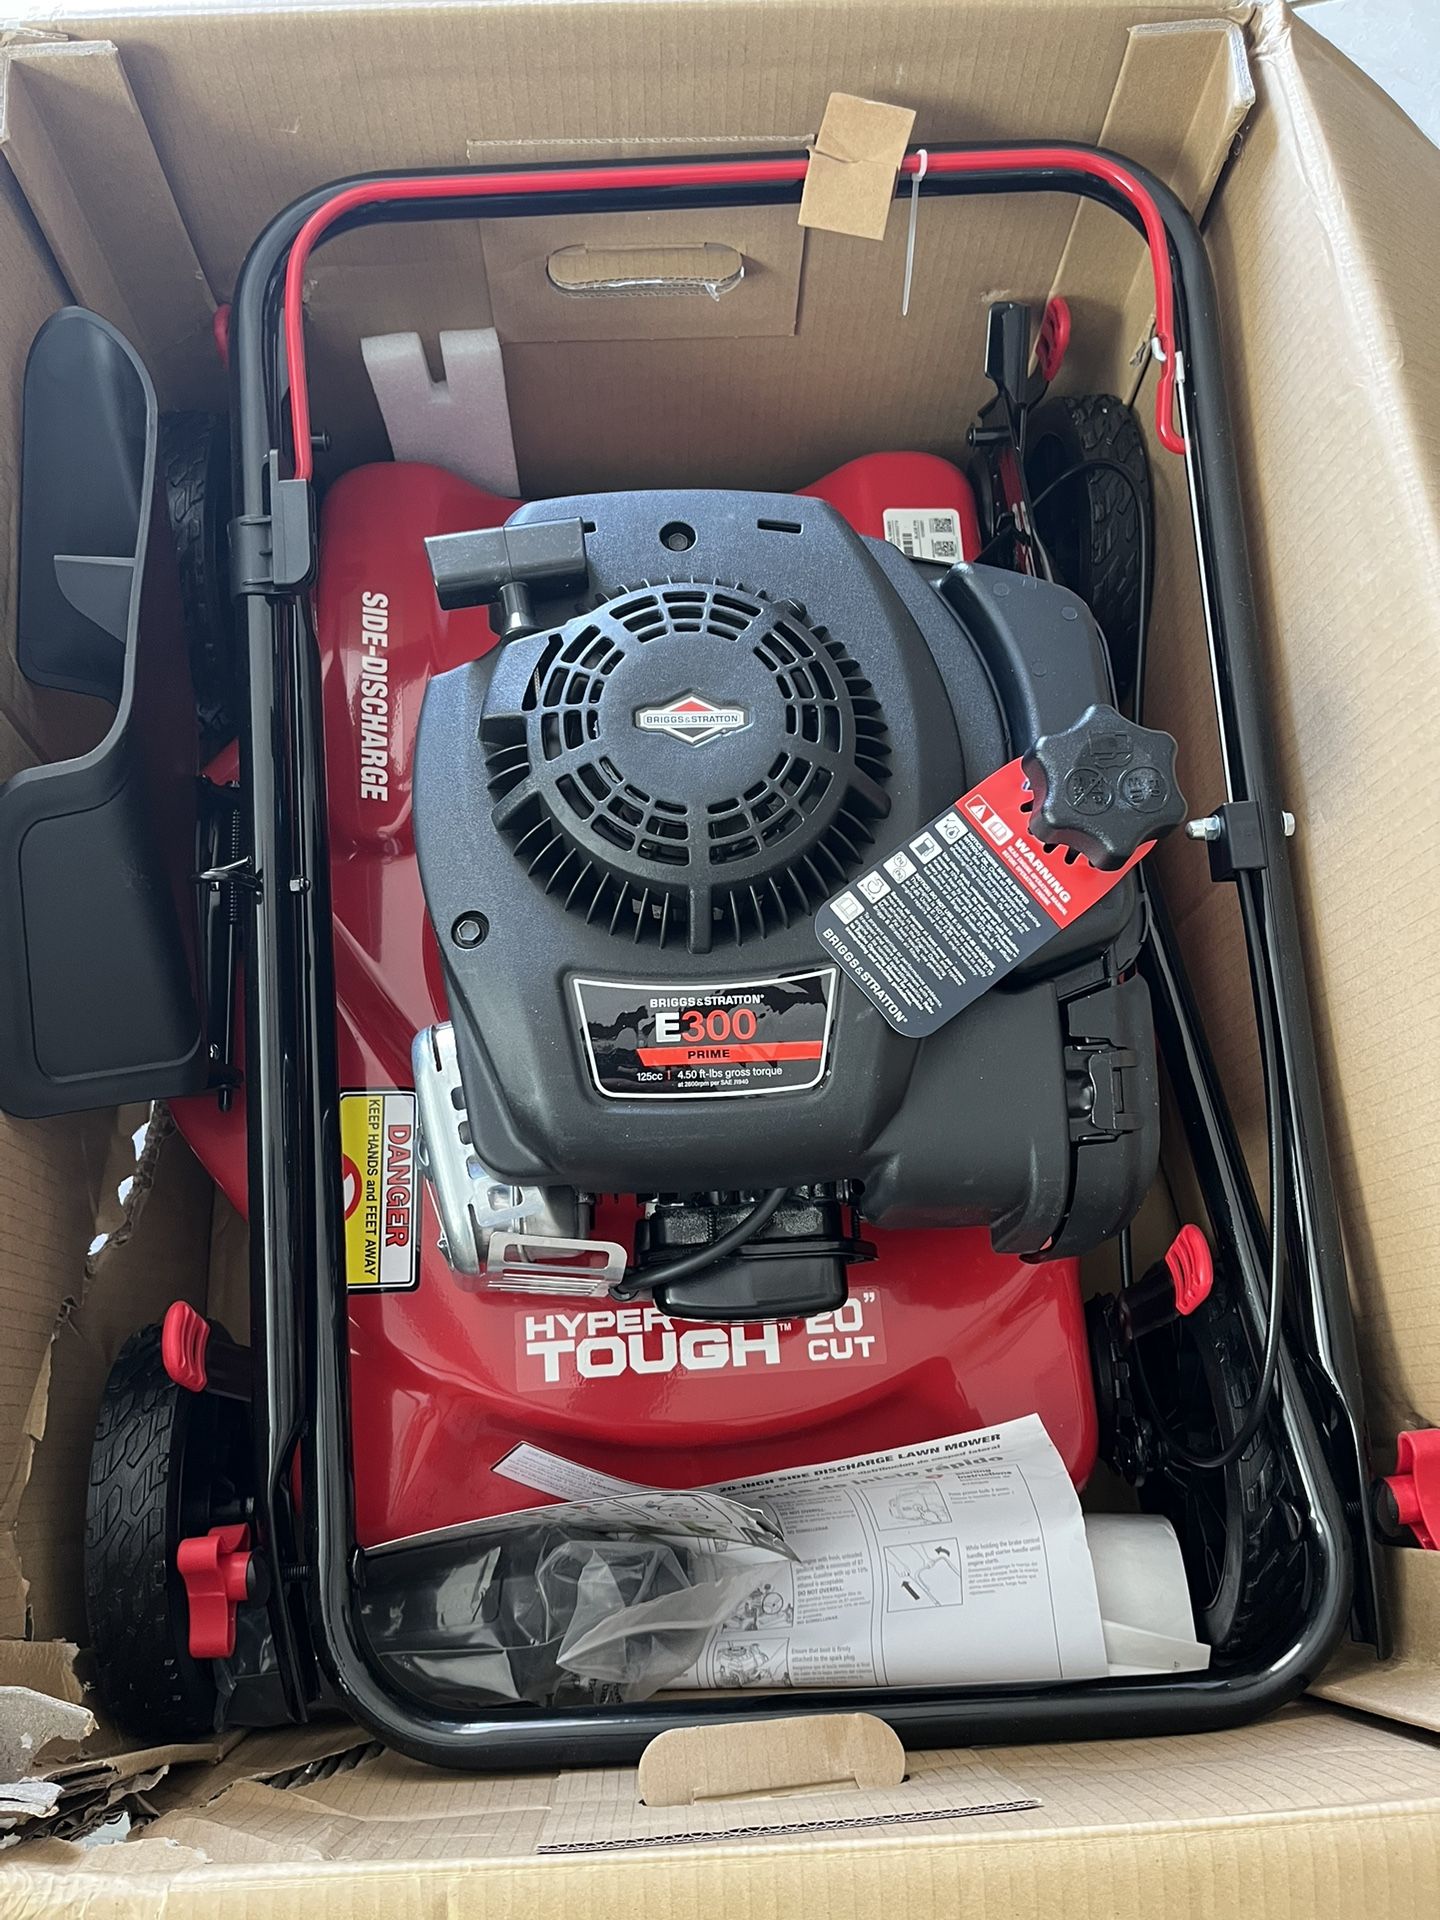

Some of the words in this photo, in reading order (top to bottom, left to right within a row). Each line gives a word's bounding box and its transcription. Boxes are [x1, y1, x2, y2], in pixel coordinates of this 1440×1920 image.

[361, 591, 387, 800] SIDE-DISCHARGE
[646, 714, 738, 724] BRIGGS&STRATTON
[1014, 836, 1072, 903] WARNING
[655, 1008, 757, 1042] E300
[687, 1049, 730, 1059] PRIME
[636, 1072, 663, 1081] 125cc
[677, 1070, 697, 1080] 4.50
[699, 1069, 722, 1079] ft-lbs
[725, 1069, 750, 1080] gross
[752, 1066, 783, 1078] torque
[720, 1079, 733, 1087] SAE
[368, 1099, 379, 1129] KEEP
[367, 1133, 378, 1175] HANDS
[366, 1180, 377, 1201] and
[385, 1124, 411, 1247] DANGER
[365, 1205, 377, 1235] FEET
[364, 1239, 375, 1275] AWAY
[525, 1308, 674, 1340] HYPER
[808, 1336, 875, 1361] CUT
[718, 1477, 774, 1493] 20-INCH
[778, 1471, 809, 1482] SIDE
[814, 1454, 893, 1476] DISCHARGE
[897, 1445, 939, 1460] LAWN
[944, 1433, 1001, 1451] MOWER
